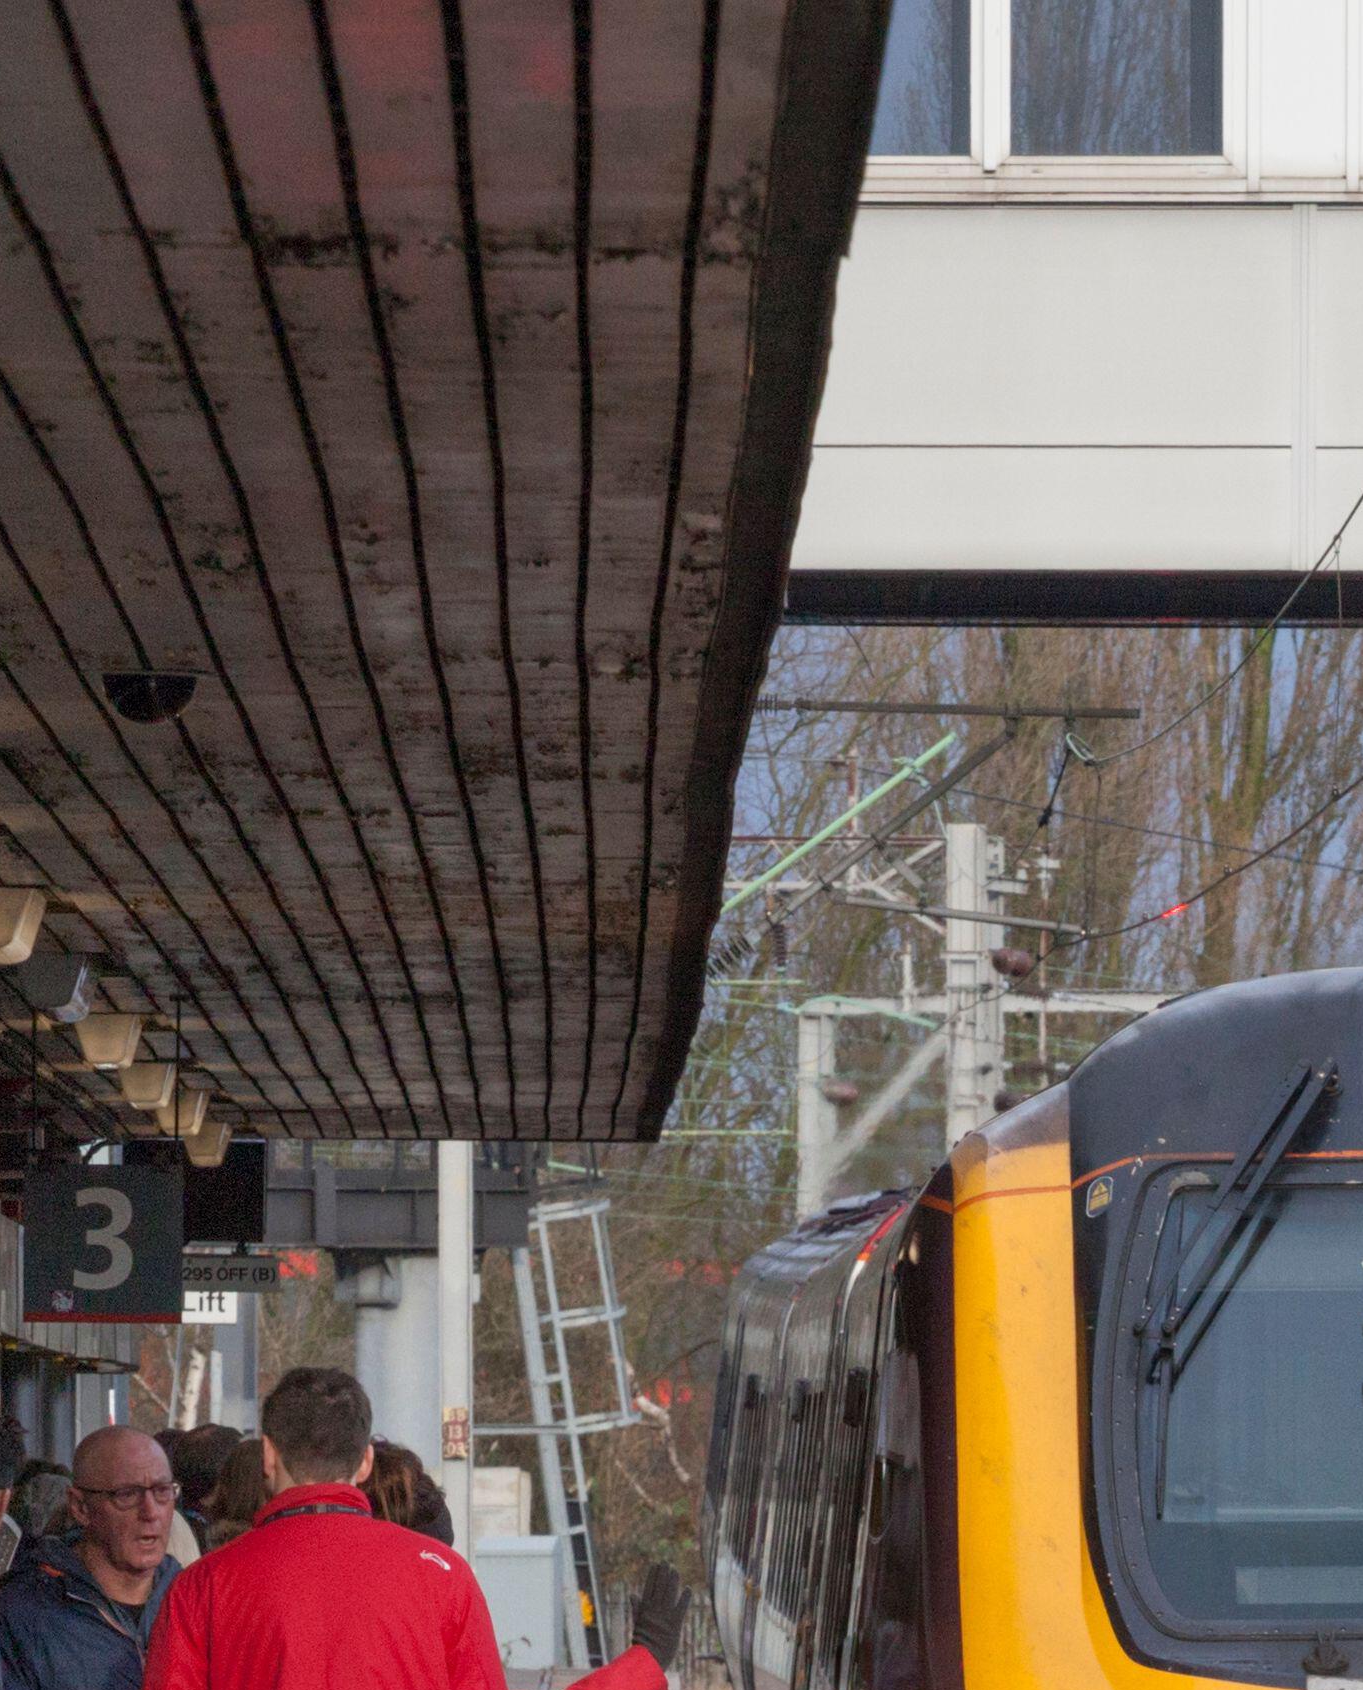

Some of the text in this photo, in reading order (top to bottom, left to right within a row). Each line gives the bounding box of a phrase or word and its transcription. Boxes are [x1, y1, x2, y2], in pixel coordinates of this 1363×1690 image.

[73, 1187, 133, 1290] 3
[182, 1267, 276, 1284] 295 OFF (B)
